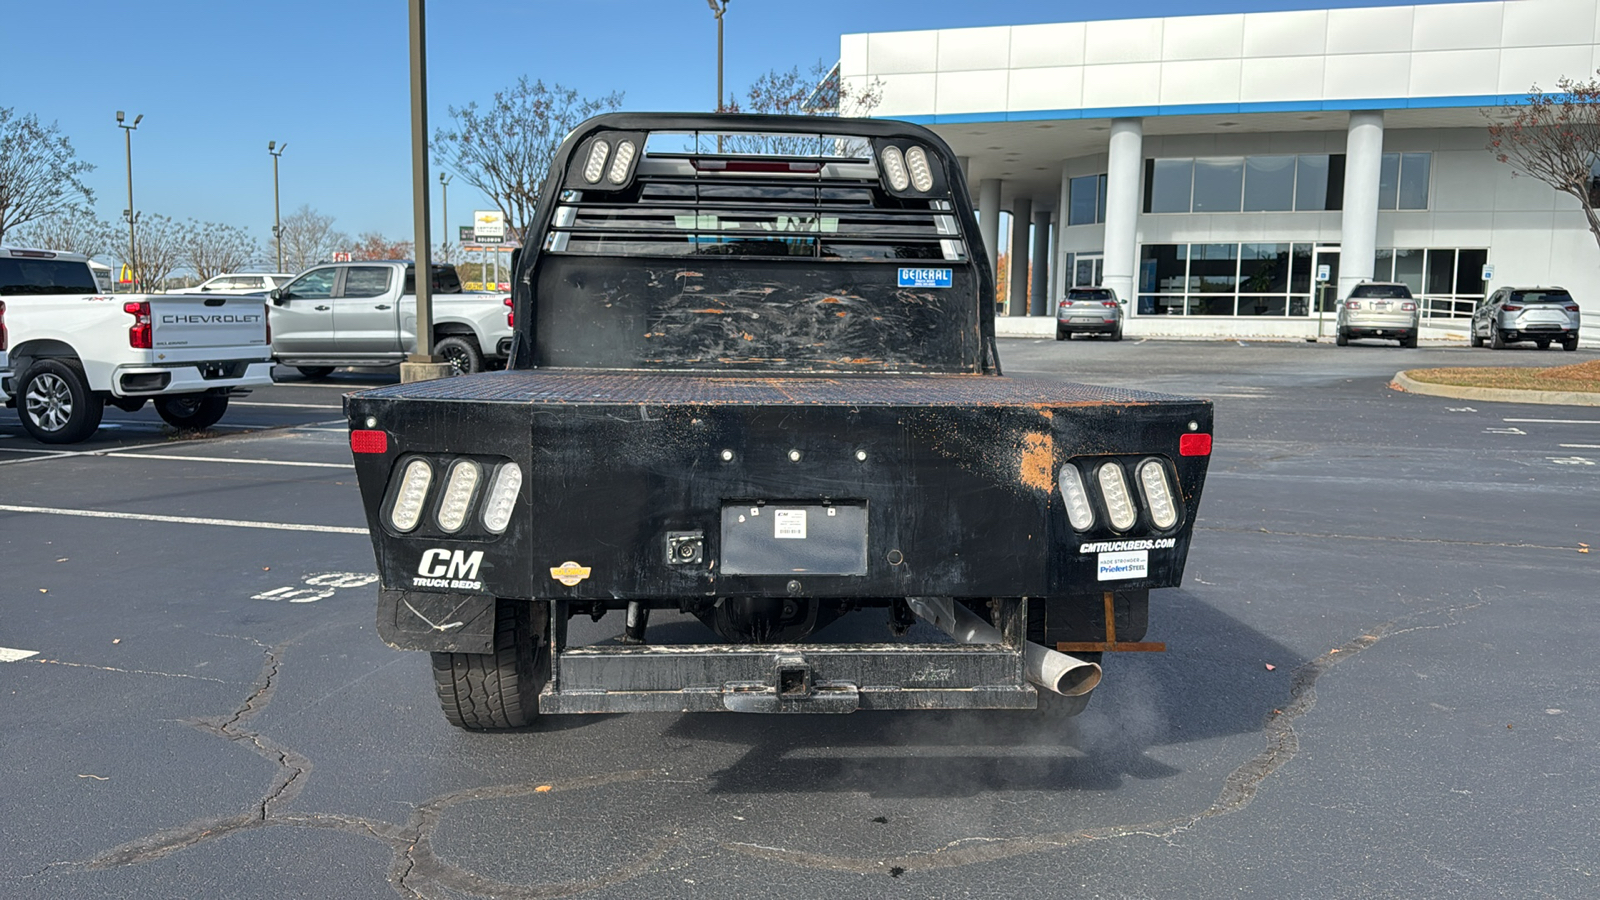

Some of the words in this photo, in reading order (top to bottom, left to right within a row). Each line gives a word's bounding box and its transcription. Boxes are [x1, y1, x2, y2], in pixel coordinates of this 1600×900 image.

[902, 270, 948, 280] GENERAL
[162, 314, 261, 324] CHEVROLET
[1079, 538, 1176, 554] CMTRUCKBEDS.COM
[417, 548, 484, 580] CM
[1100, 565, 1128, 574] Priefert
[1128, 564, 1146, 572] STEEL
[412, 577, 450, 588] TRUCK
[450, 580, 482, 590] BEDS
